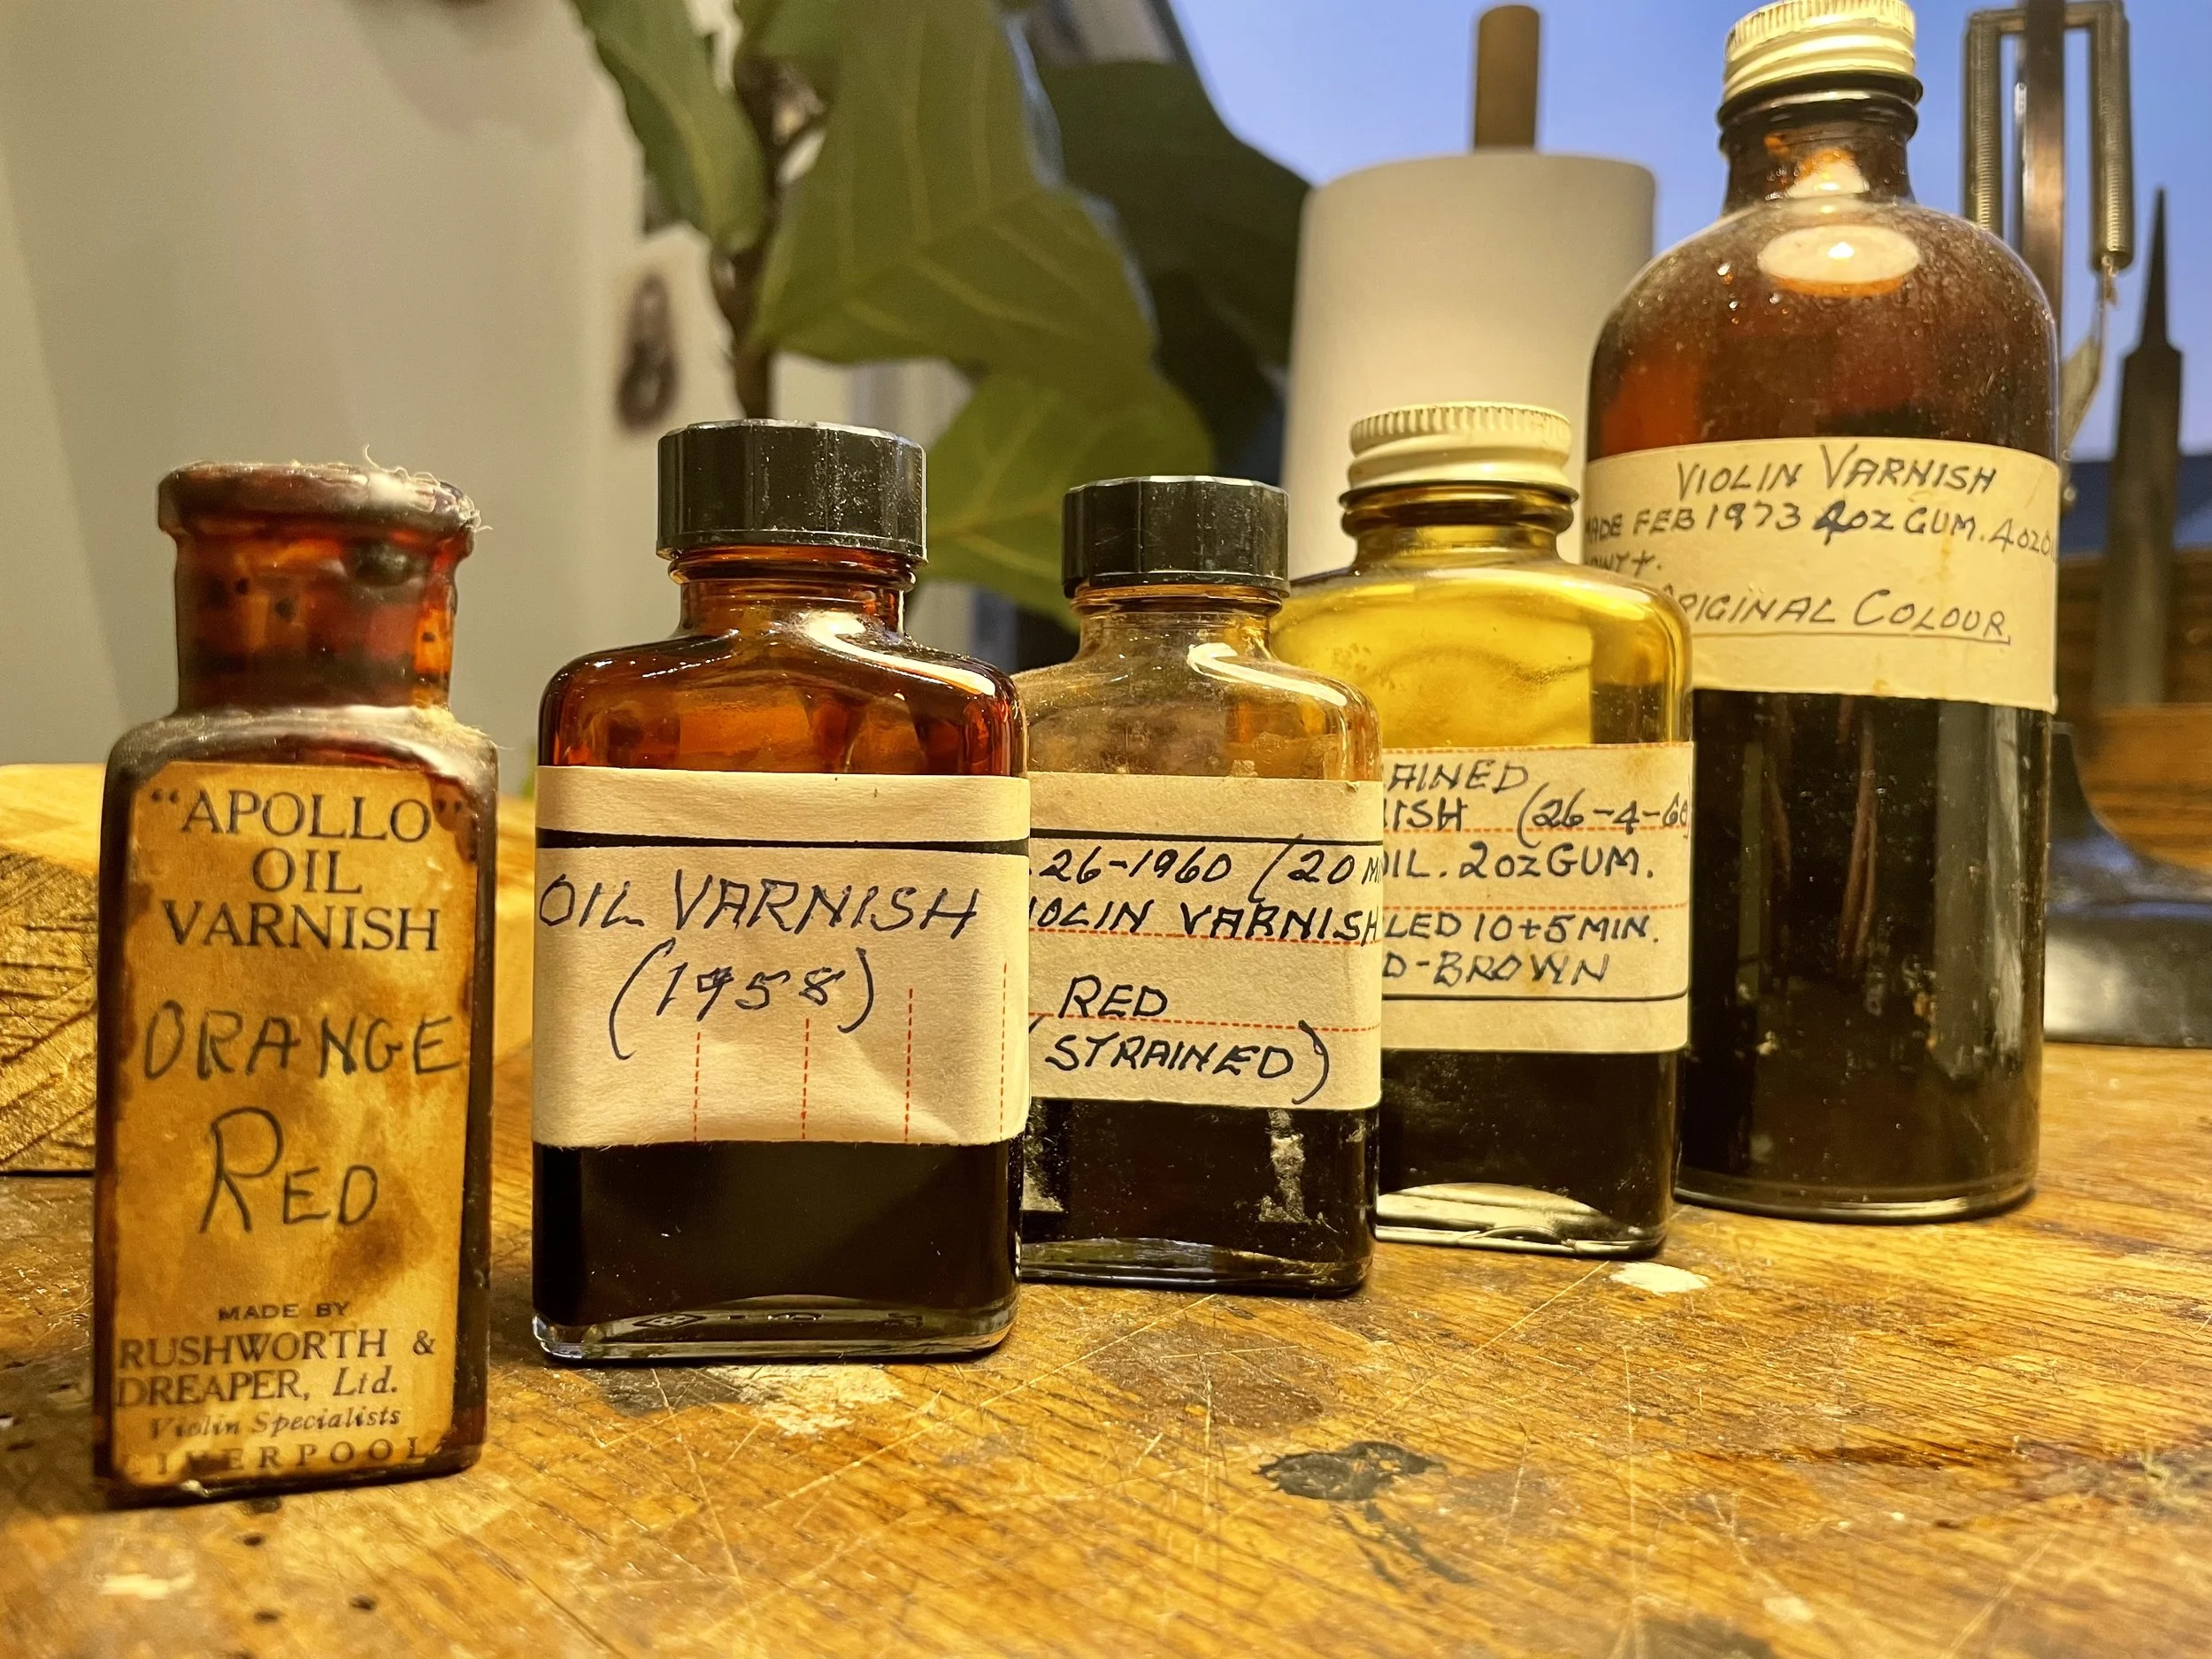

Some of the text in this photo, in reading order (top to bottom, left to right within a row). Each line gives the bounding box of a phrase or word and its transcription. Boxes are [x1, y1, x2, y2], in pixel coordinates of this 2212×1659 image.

[1678, 443, 1997, 502] VIOLIN VARNISH
[1632, 508, 1695, 536] FEB
[1705, 501, 1801, 533] 1973
[251, 846, 363, 895] OIL
[160, 899, 441, 953] VARNISH
[539, 869, 980, 940] OIL VARNISH
[1179, 901, 1379, 947] VARNISH
[1058, 974, 1169, 1019] RED
[143, 998, 463, 1081] ORANGE
[218, 1302, 352, 1322] MADE BY
[118, 1328, 436, 1370] RUSHWORTH &
[116, 1365, 399, 1408] DREAPER, Ltd.
[250, 1405, 403, 1439] Specialists
